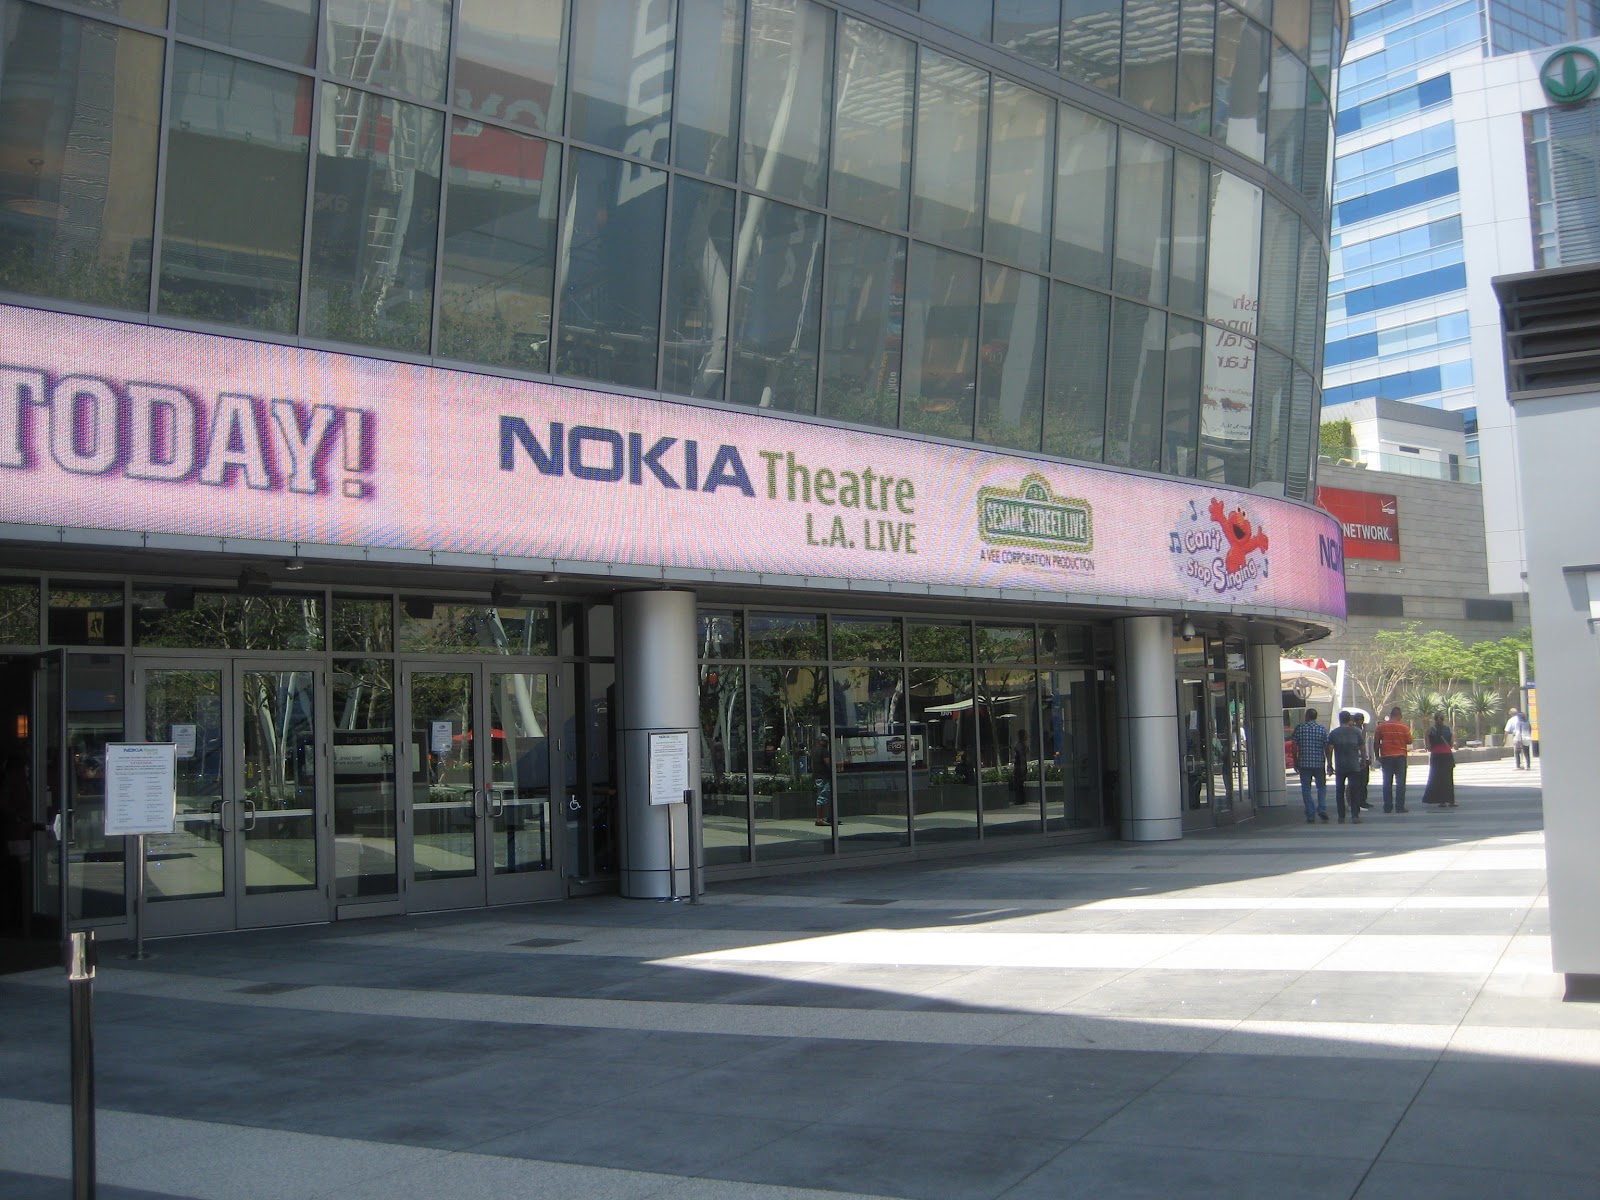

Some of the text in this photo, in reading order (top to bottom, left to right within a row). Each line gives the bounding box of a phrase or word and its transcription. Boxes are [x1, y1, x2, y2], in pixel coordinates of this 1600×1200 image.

[499, 414, 916, 514] NOKIA Theatre
[806, 512, 918, 554] L.A. LIVE
[985, 501, 1085, 539] SESAME STREET LIVE
[1343, 522, 1393, 541] NETWORK.
[1185, 528, 1222, 554] Can't
[1001, 551, 1051, 568] CORPORATION
[1052, 554, 1095, 571] PRODUCTION
[1187, 557, 1258, 593] Stop Singing
